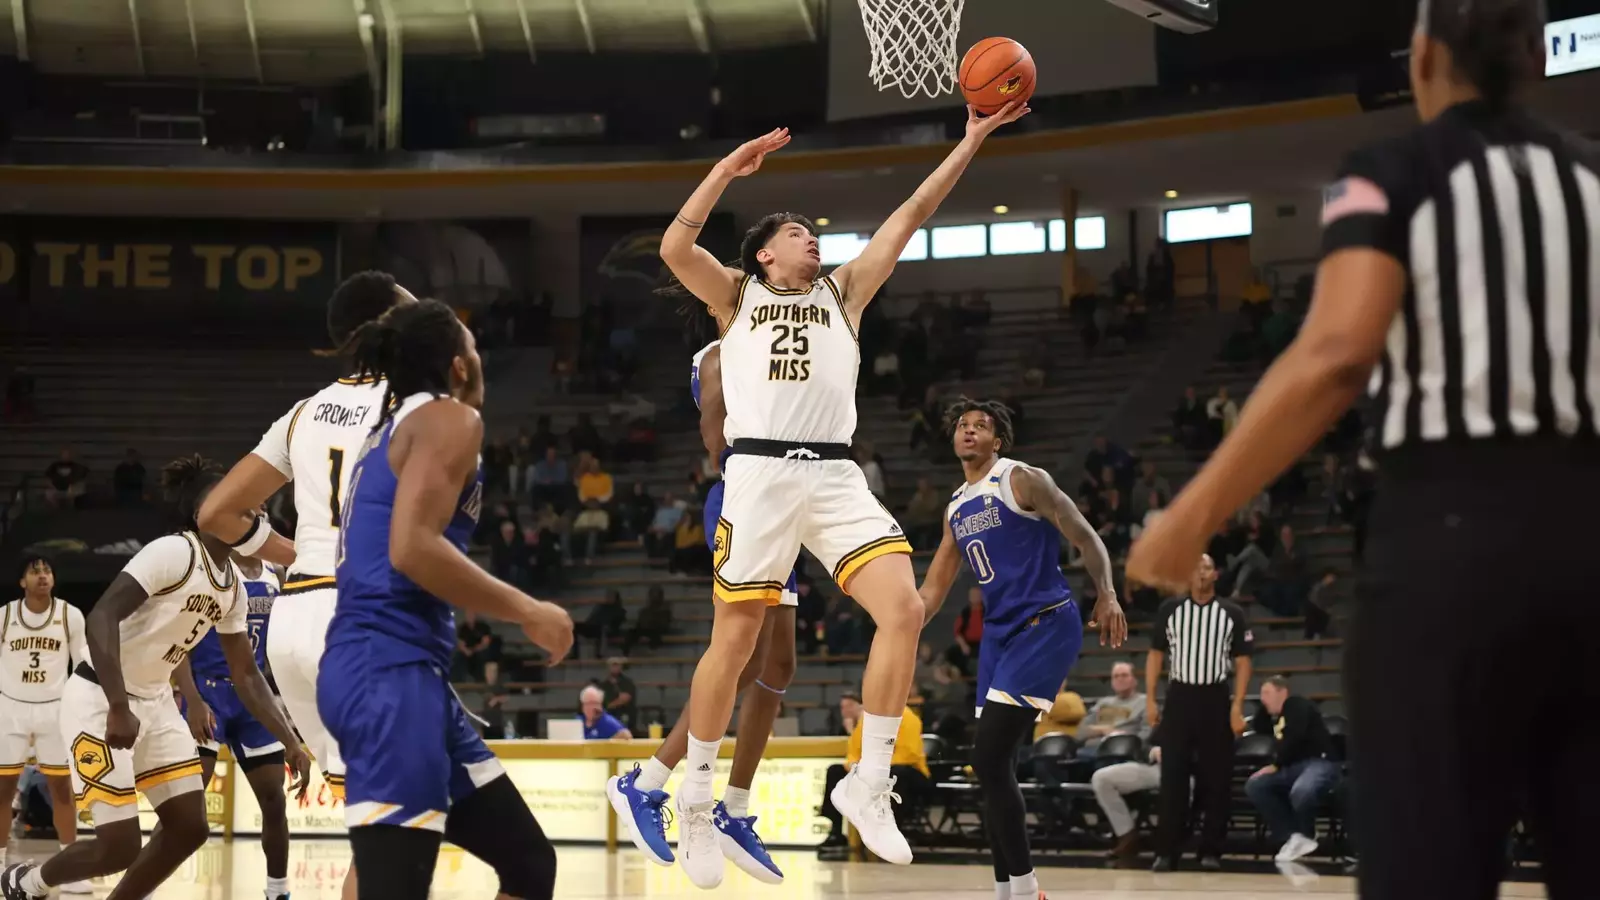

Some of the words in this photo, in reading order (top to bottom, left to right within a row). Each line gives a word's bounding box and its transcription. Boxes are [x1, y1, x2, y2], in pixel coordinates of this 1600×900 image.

[35, 243, 172, 288] THE
[191, 245, 322, 292] TOP
[750, 303, 831, 332] SOUTHERN
[771, 325, 809, 356] 25
[768, 359, 811, 382] MISS
[328, 446, 344, 530] 1
[966, 539, 995, 584] 0
[10, 635, 62, 652] SOUTHERN
[184, 619, 206, 645] 5
[29, 652, 41, 669] 3
[162, 643, 187, 665] MISS
[21, 671, 46, 683] MISS
